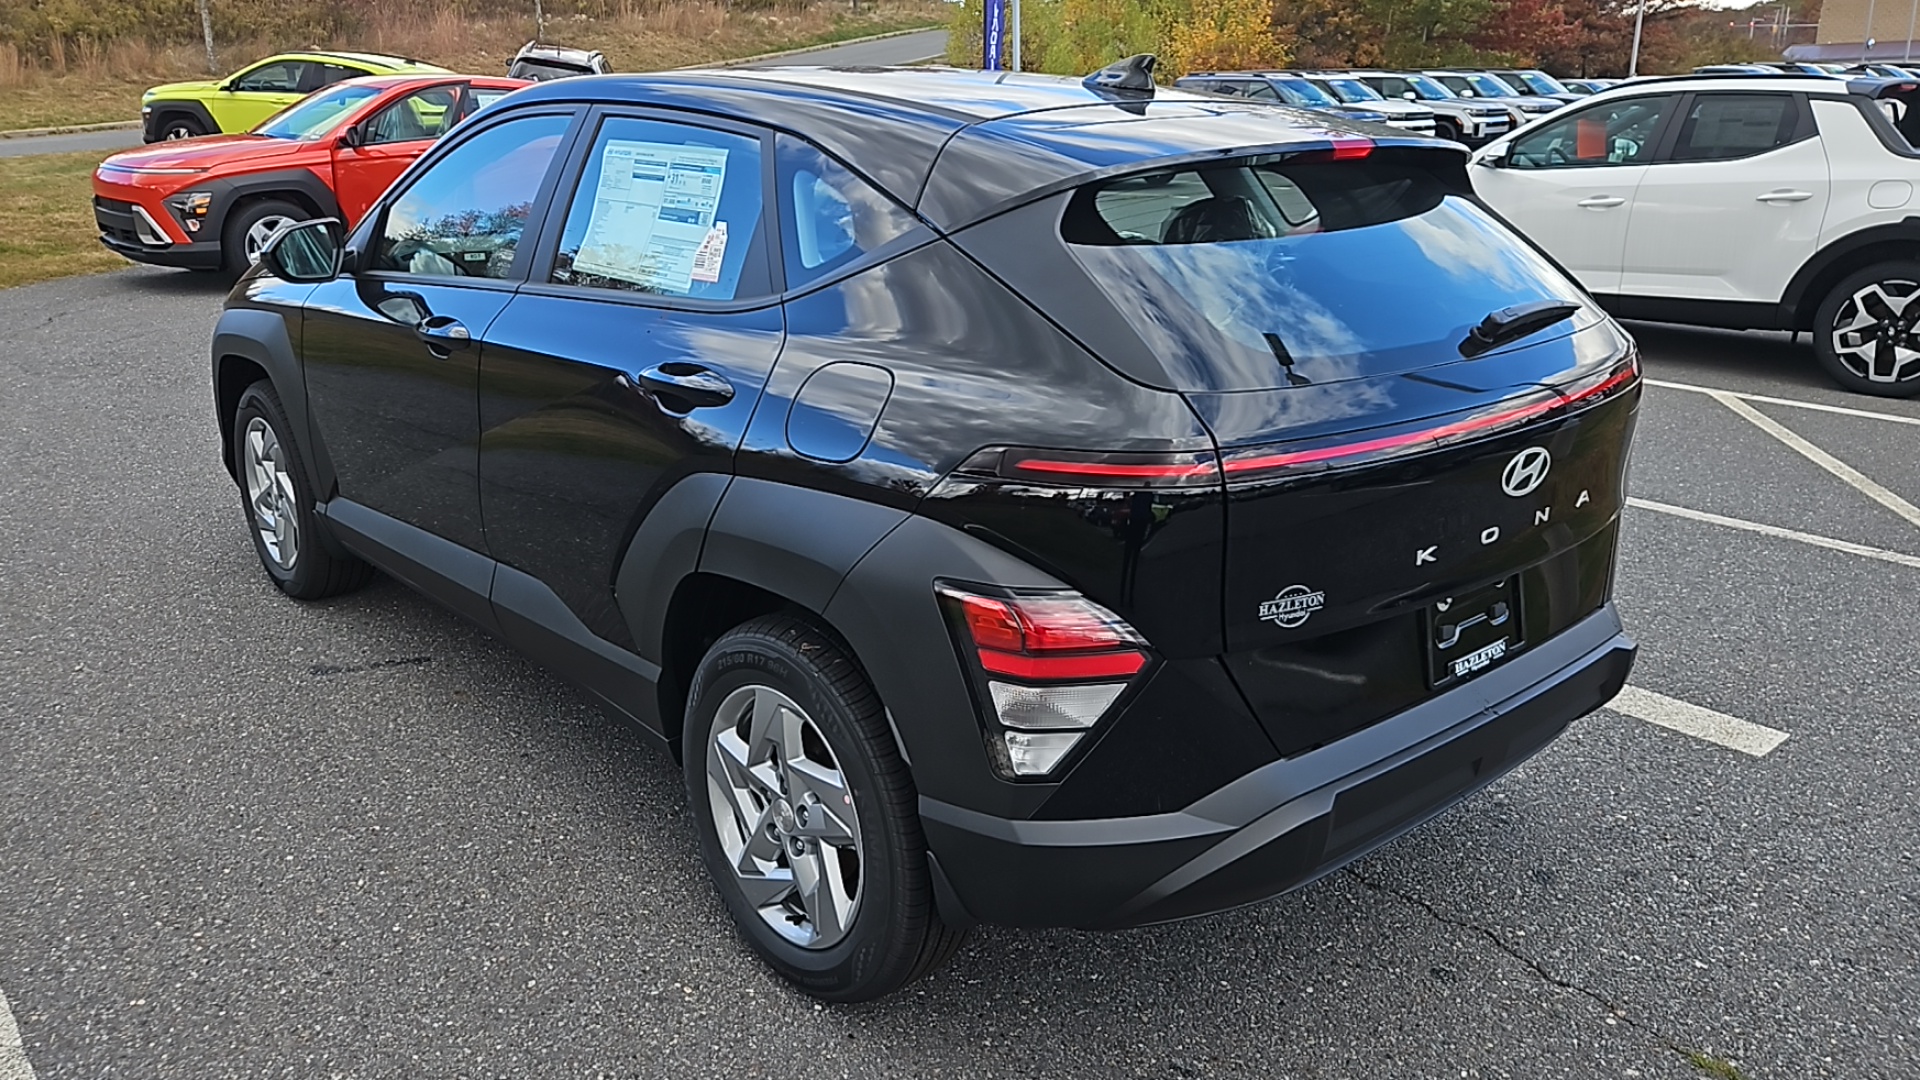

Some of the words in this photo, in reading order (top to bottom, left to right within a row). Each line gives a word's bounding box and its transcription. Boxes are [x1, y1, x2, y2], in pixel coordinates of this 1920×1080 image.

[1416, 490, 1590, 566] KONA
[1259, 594, 1325, 616] HAZLETON
[1455, 642, 1506, 674] HAZLETON
